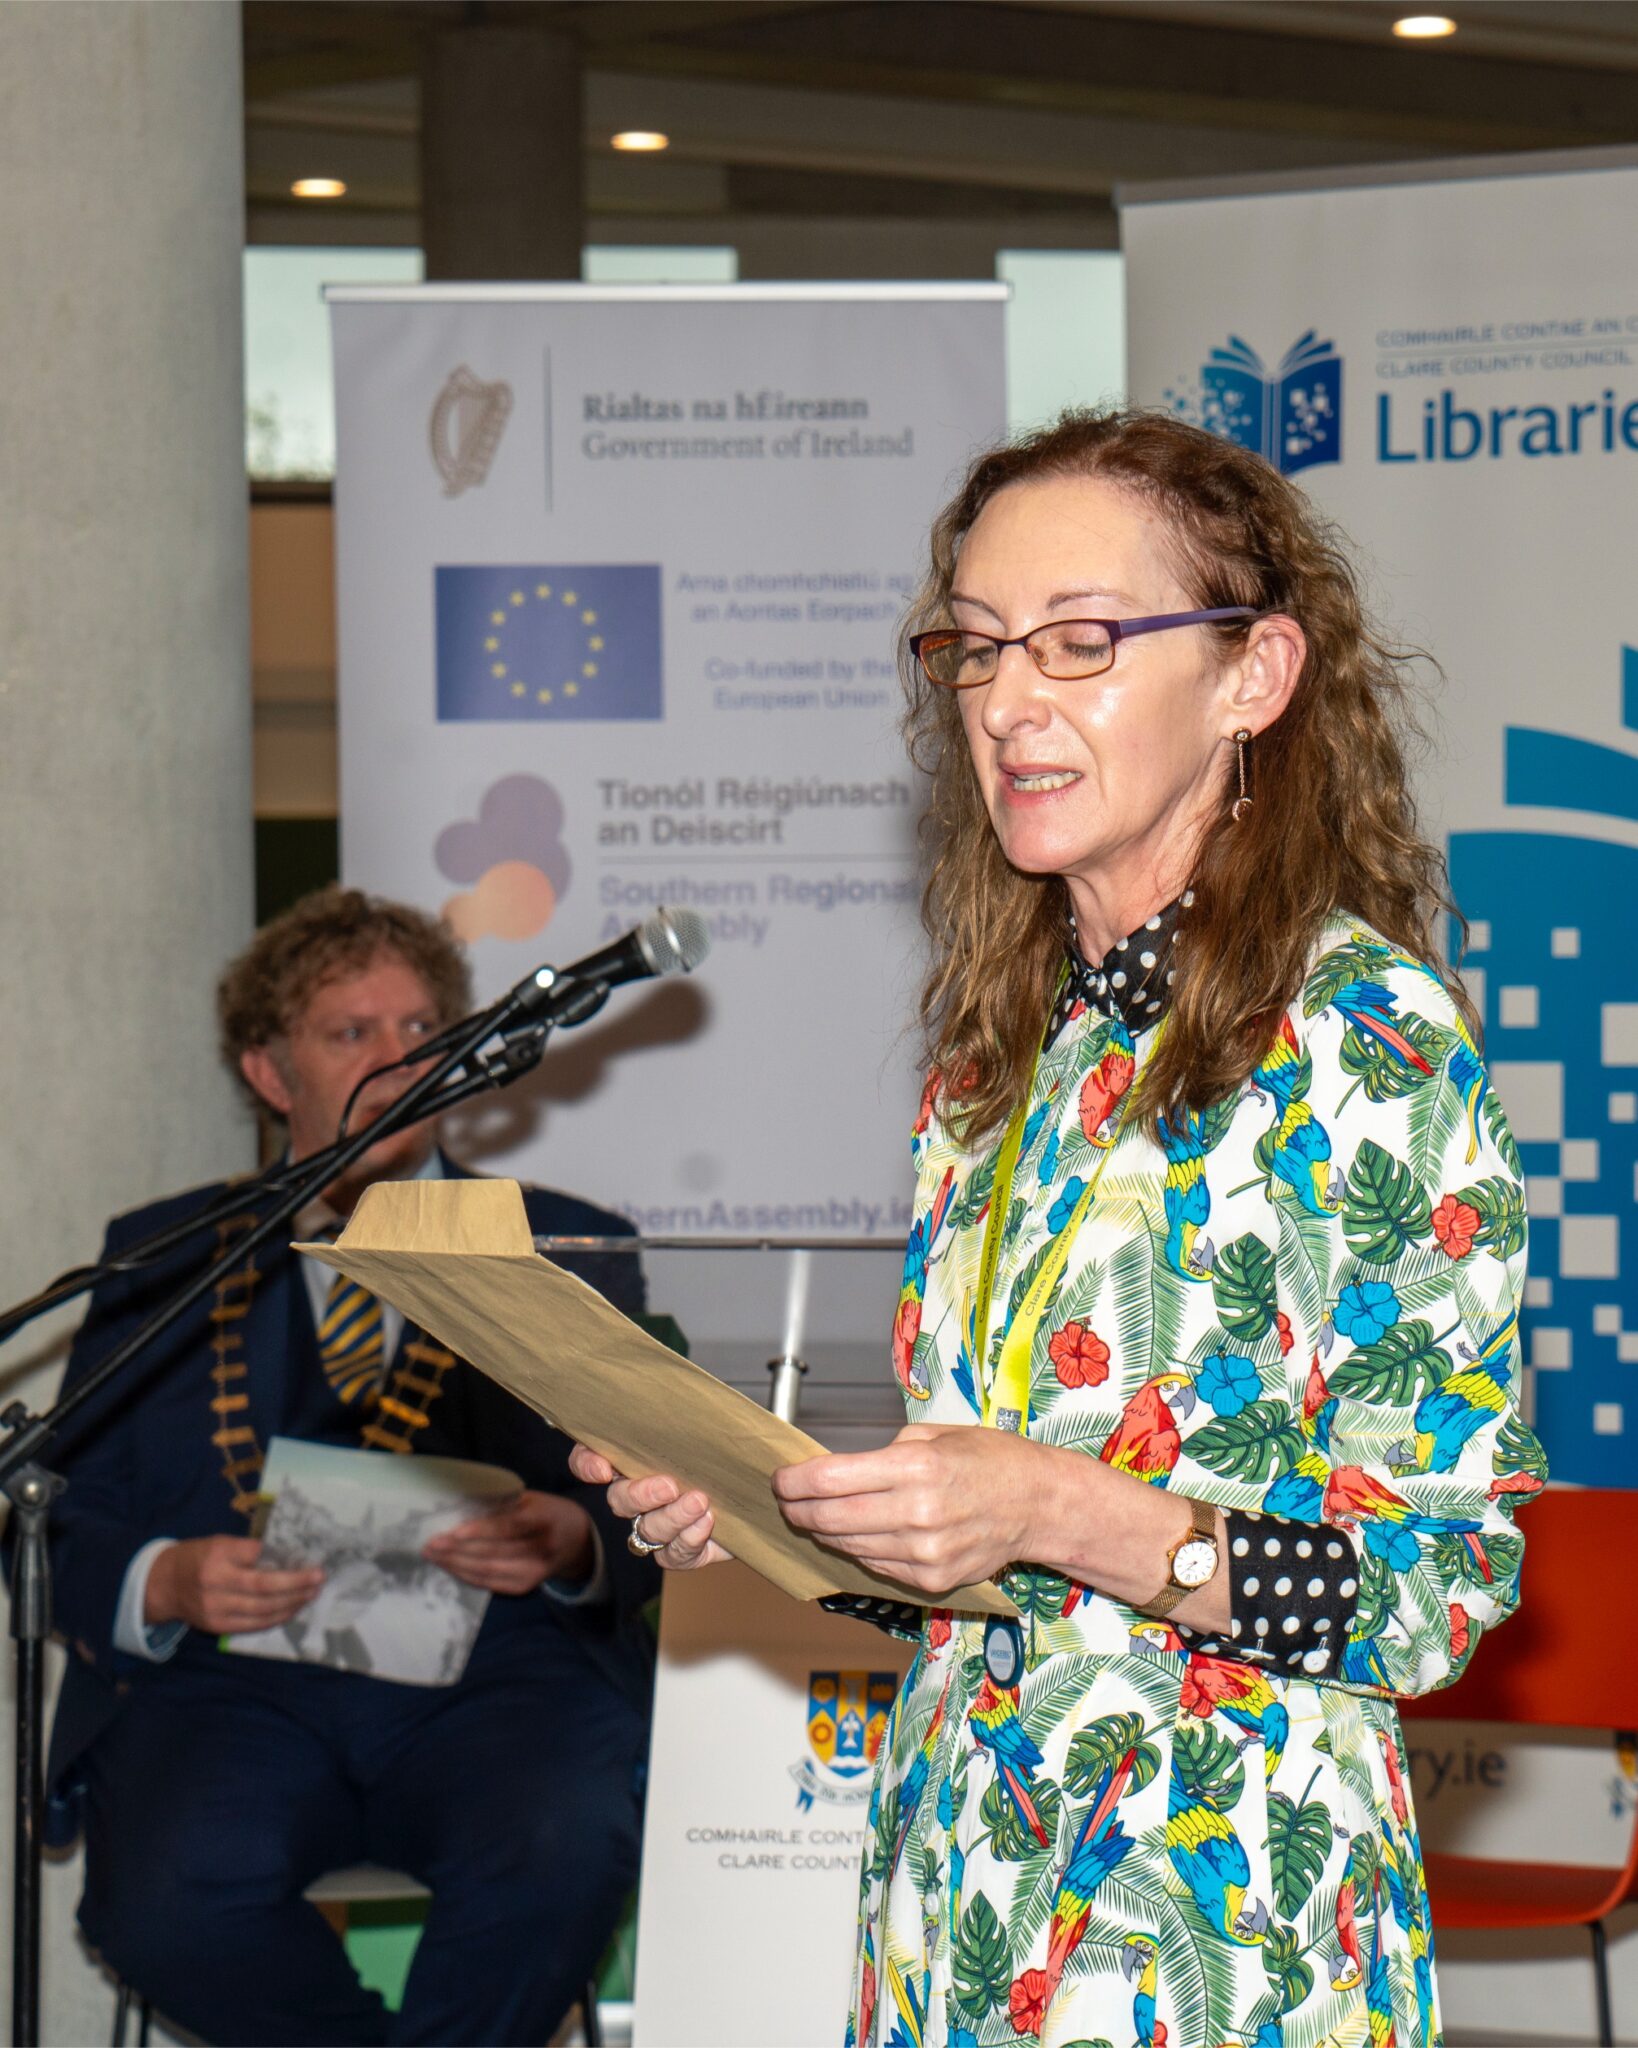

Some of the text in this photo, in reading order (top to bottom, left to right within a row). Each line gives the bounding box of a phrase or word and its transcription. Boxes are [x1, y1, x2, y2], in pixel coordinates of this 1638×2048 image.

[1376, 349, 1633, 379] CLARE COUNTY COUNCIL
[583, 392, 685, 421] Rialtas
[692, 400, 726, 421] na
[582, 426, 914, 460] Government of Ireland
[704, 657, 896, 683] Co-funded by the
[714, 687, 889, 712] European Union
[598, 812, 786, 847] an Deiscirt
[600, 874, 757, 905] Southern
[983, 1236, 997, 1284] County
[1025, 1278, 1048, 1316] Clare
[1045, 1226, 1073, 1276] County
[685, 1826, 803, 1845] COMHAIRLE
[717, 1853, 785, 1871] CLARE
